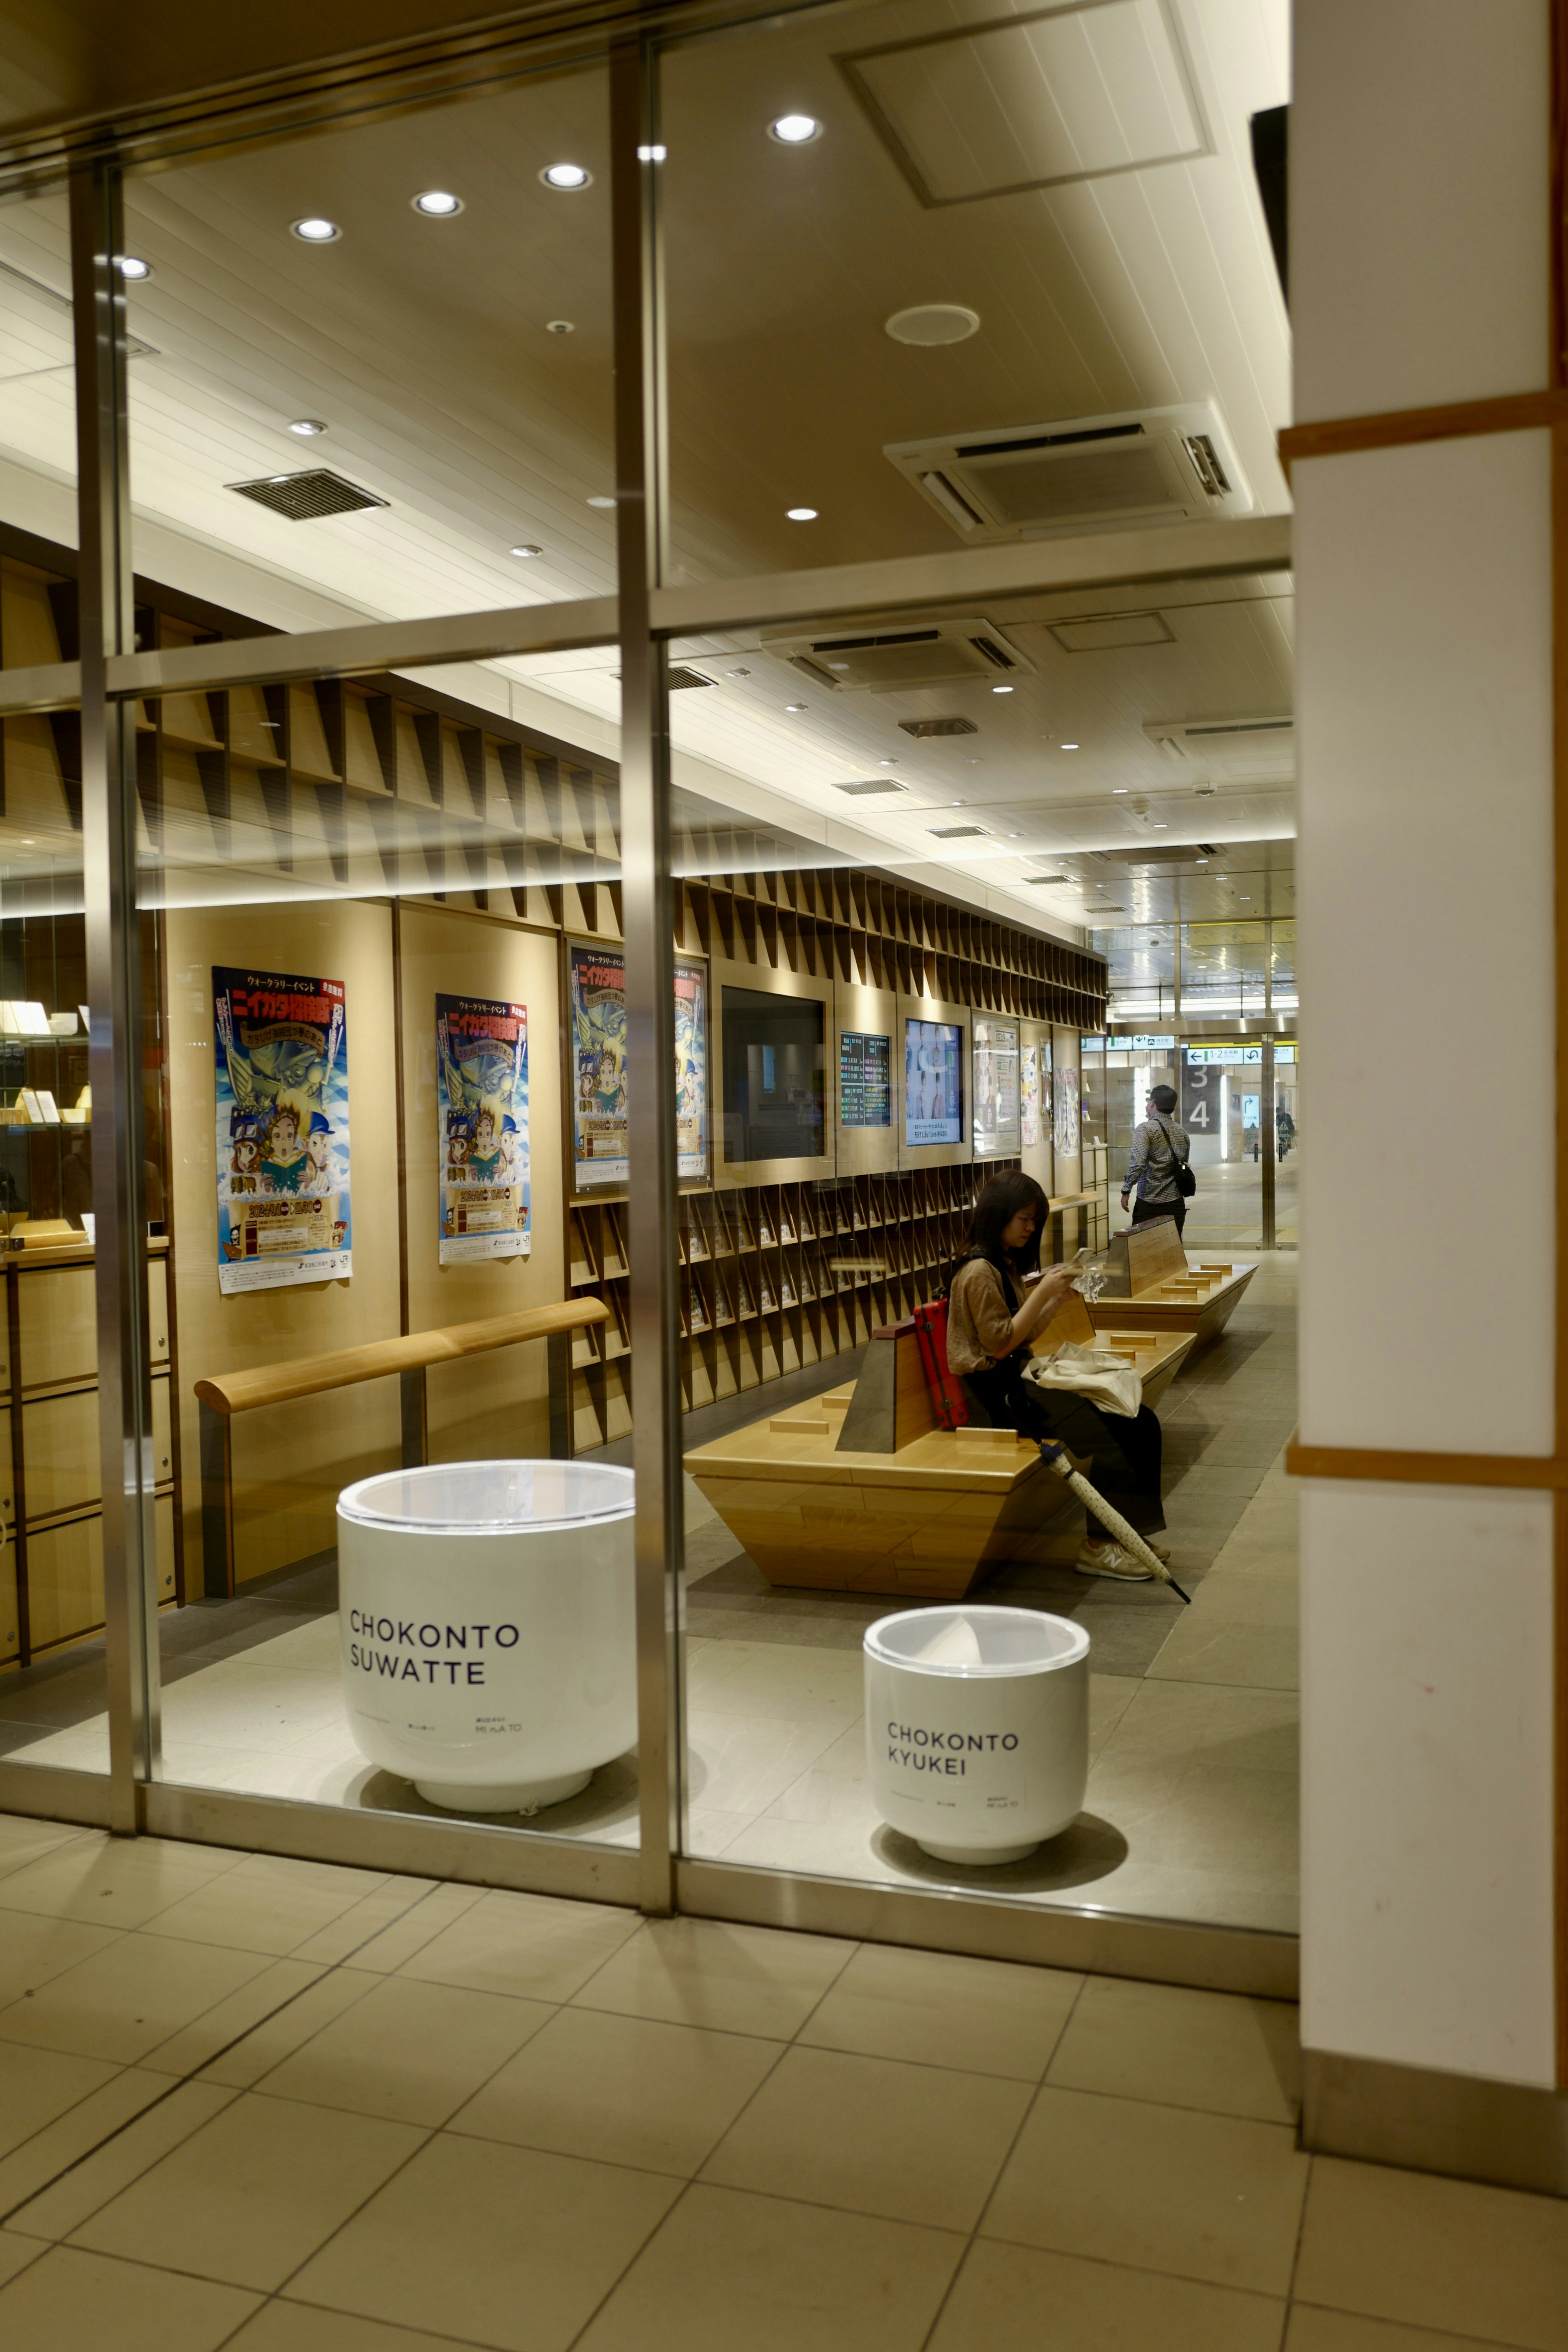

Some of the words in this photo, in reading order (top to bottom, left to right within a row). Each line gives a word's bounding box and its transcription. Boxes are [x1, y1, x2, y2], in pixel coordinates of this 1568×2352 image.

[248, 976, 314, 992] ウォークラリーイベント
[459, 1001, 506, 1015] ウォークラリーイベント
[1191, 1065, 1208, 1087] 3
[1190, 1101, 1209, 1127] 4
[340, 1255, 348, 1263] JR
[350, 1609, 519, 1649] CHOKONTO
[351, 1644, 485, 1685] SUWATTE
[888, 1722, 1019, 1752] CHOKONTO
[888, 1745, 965, 1776] KYUKEI
